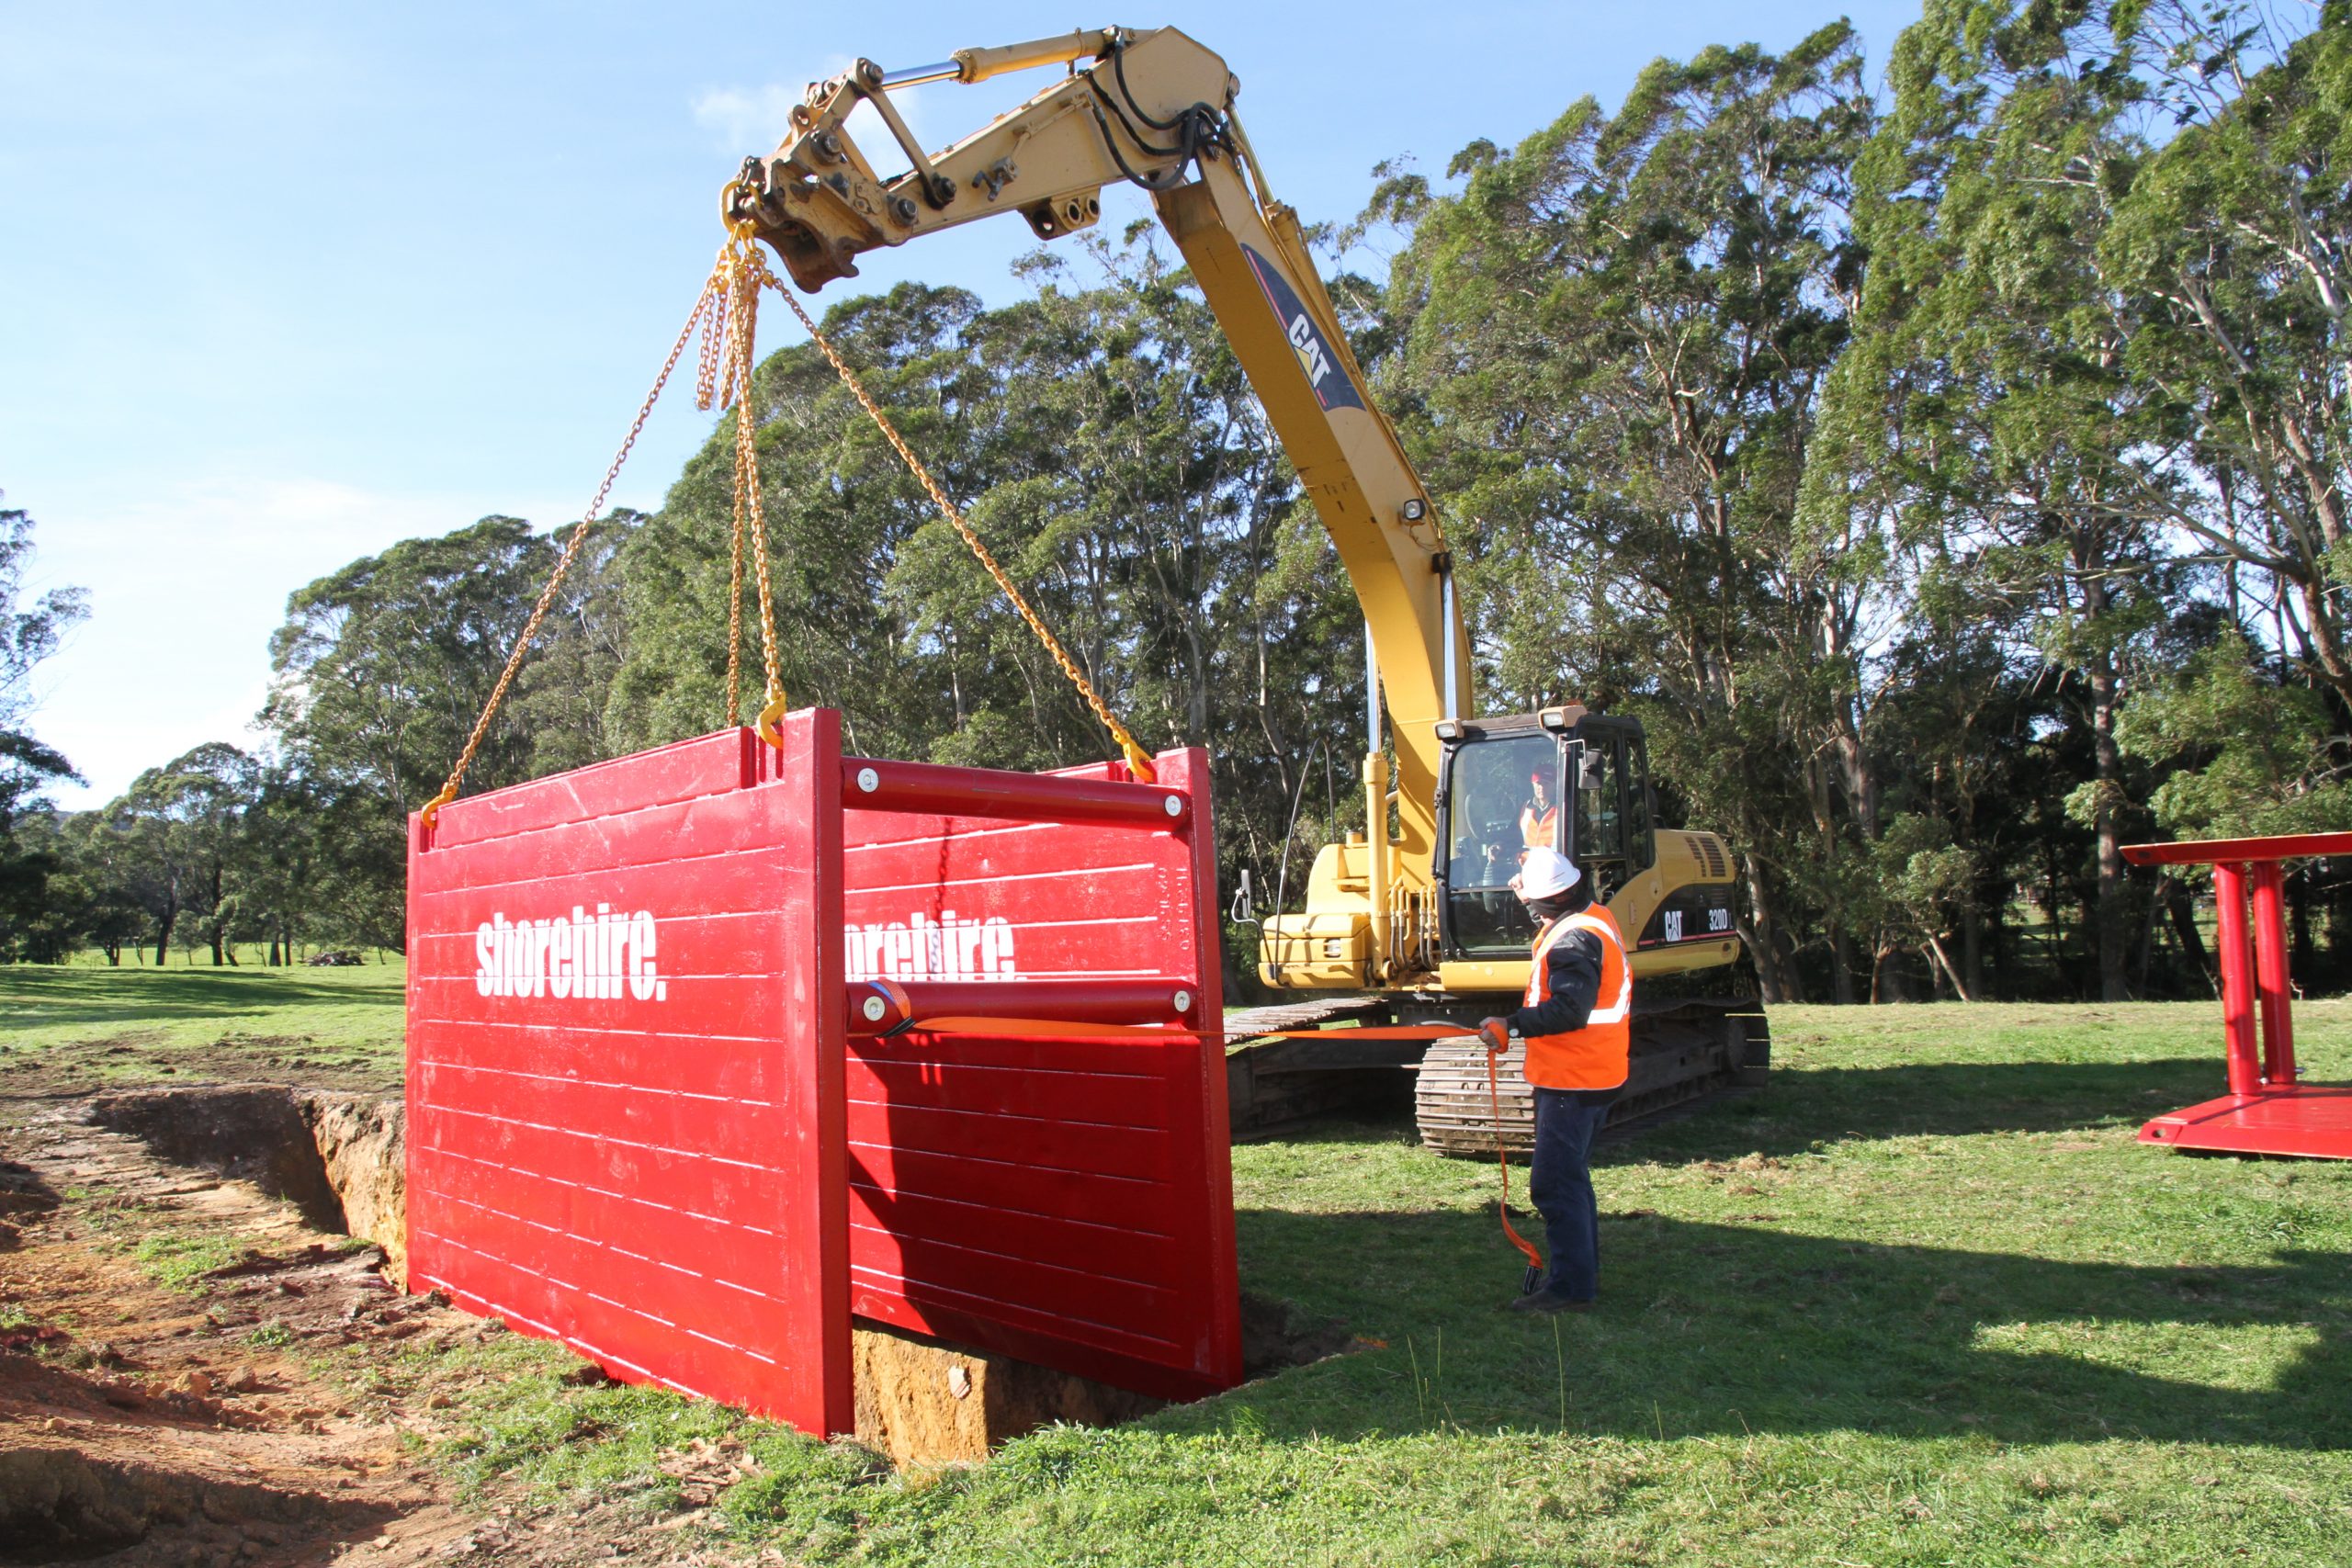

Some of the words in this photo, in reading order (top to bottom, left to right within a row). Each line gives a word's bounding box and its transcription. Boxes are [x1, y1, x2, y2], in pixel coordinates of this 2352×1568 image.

[1288, 313, 1331, 388] CAT
[1665, 910, 1682, 942] CAT
[1709, 908, 1727, 931] 320D
